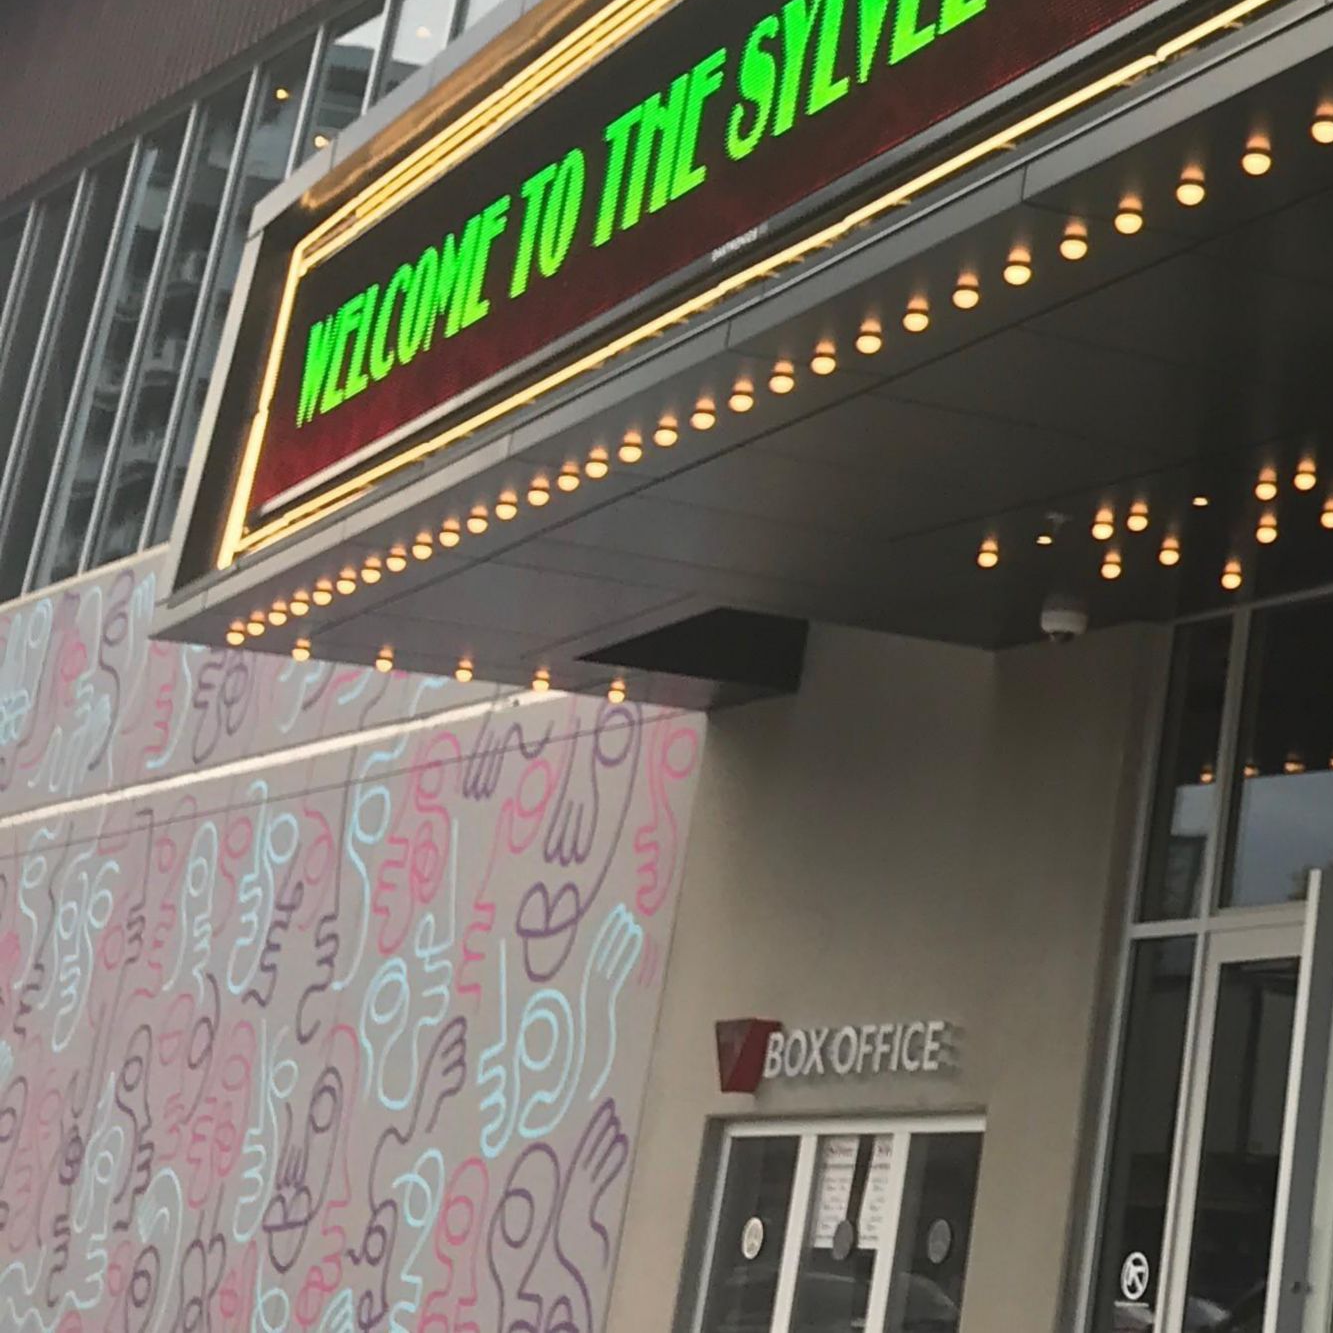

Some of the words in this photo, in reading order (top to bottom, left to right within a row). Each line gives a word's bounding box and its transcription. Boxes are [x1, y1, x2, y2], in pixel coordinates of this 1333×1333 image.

[297, 194, 511, 425] WELCOME
[509, 147, 585, 299] TO
[592, 47, 727, 247] THE
[763, 1027, 829, 1079] BOX
[830, 1020, 945, 1075] OFFICE
